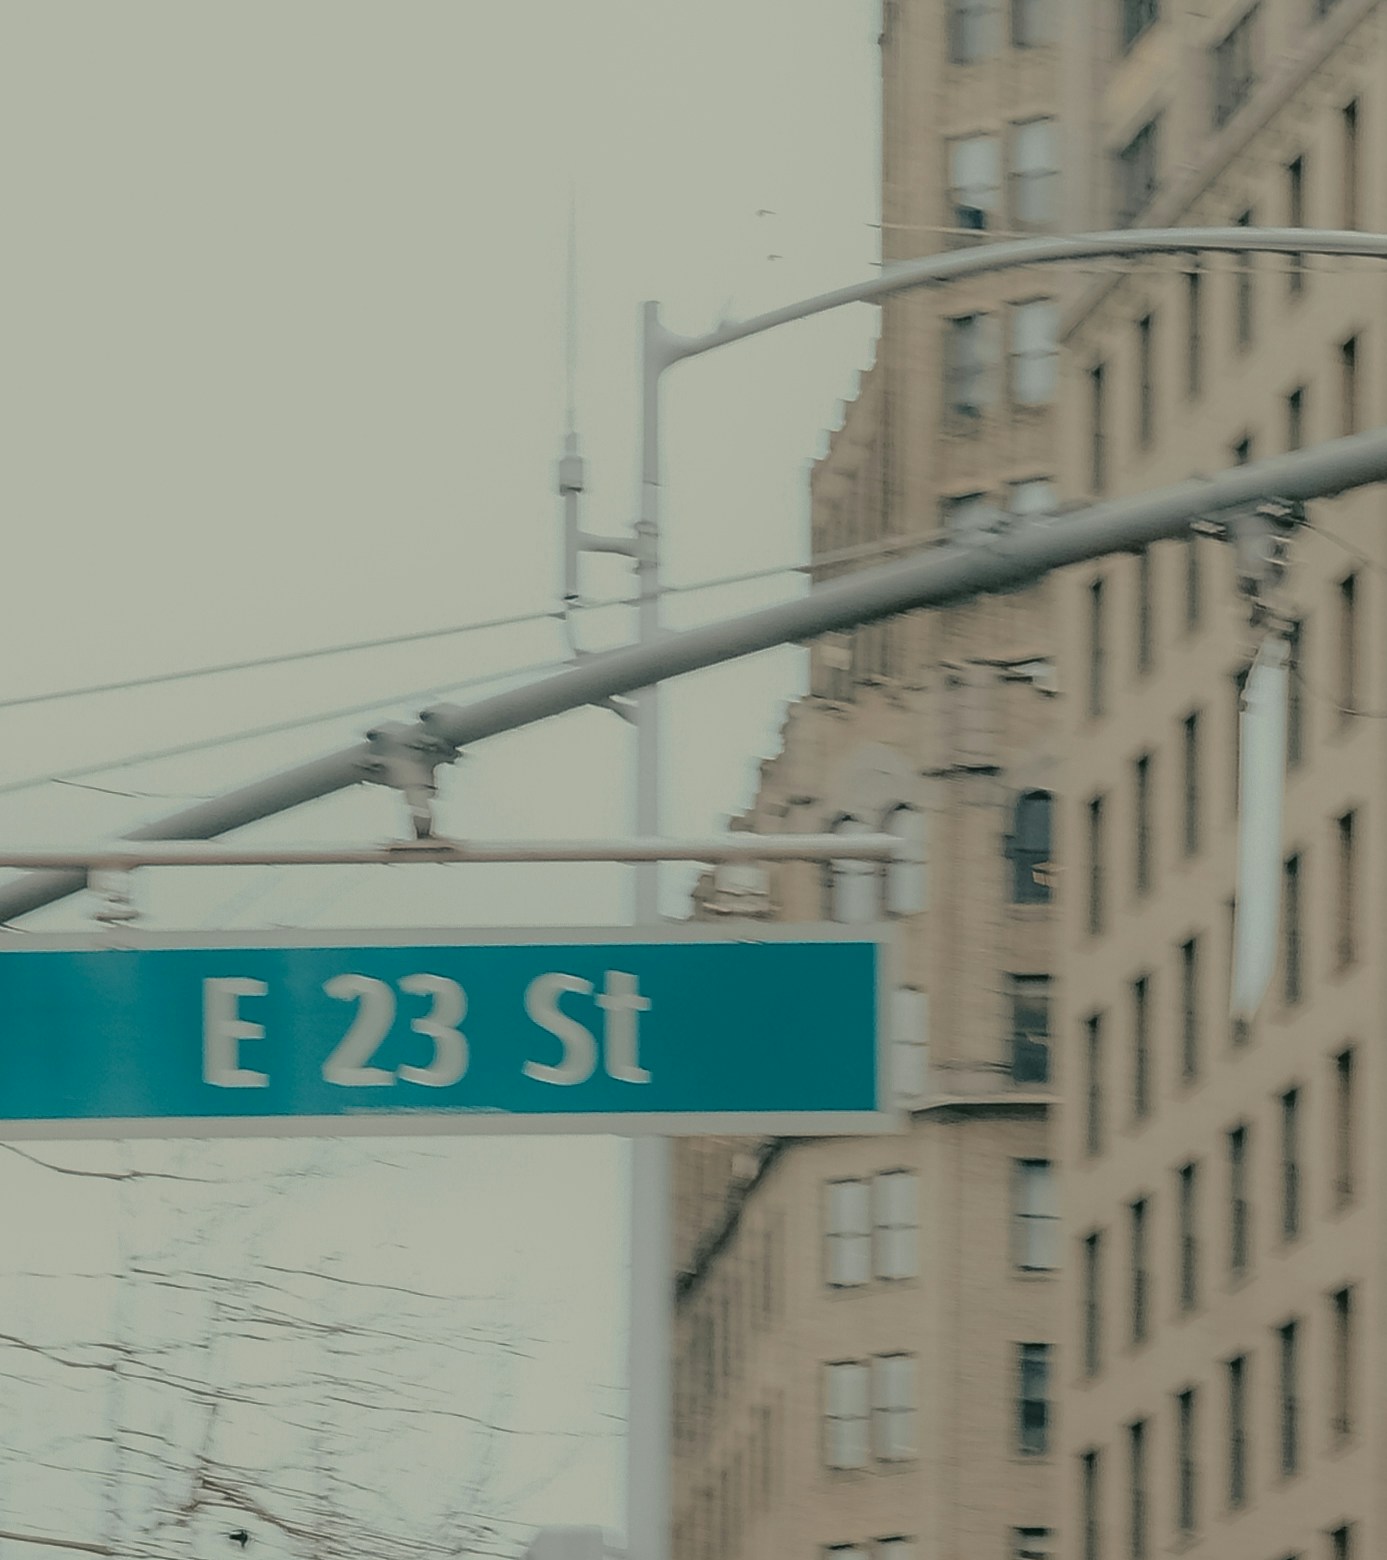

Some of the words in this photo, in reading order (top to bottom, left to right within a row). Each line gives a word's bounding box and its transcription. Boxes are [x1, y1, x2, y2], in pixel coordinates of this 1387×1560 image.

[203, 976, 270, 1087] E
[322, 973, 470, 1088] 23
[523, 970, 653, 1086] St
